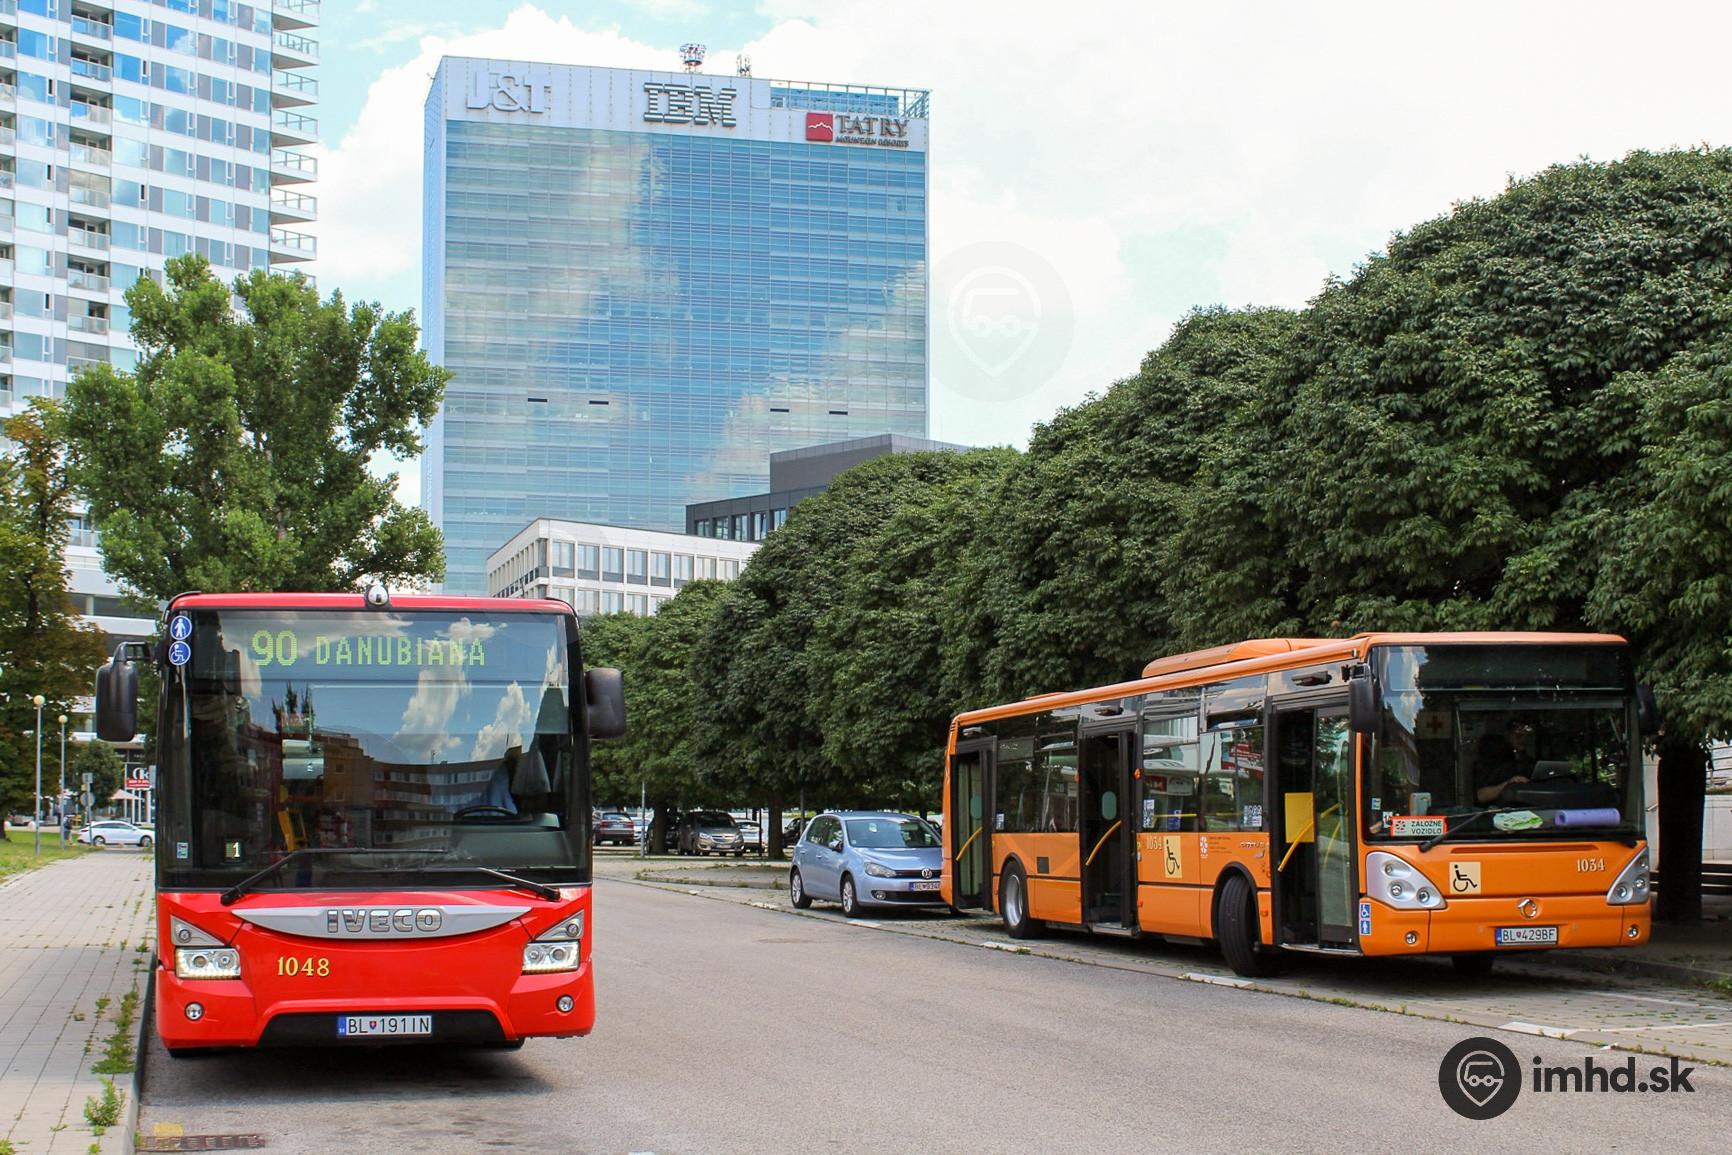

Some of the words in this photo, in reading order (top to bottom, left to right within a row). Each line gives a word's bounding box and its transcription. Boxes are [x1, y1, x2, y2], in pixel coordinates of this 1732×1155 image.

[643, 82, 737, 127] IBM
[835, 114, 909, 138] TATRY
[252, 629, 298, 666] 90
[316, 636, 485, 666] DANUBIANA
[1576, 857, 1606, 872] 1034
[326, 908, 443, 934] IVECO
[1502, 929, 1517, 941] BL
[1521, 928, 1556, 940] 429BF
[277, 956, 331, 978] 1048
[348, 1018, 369, 1034] BL
